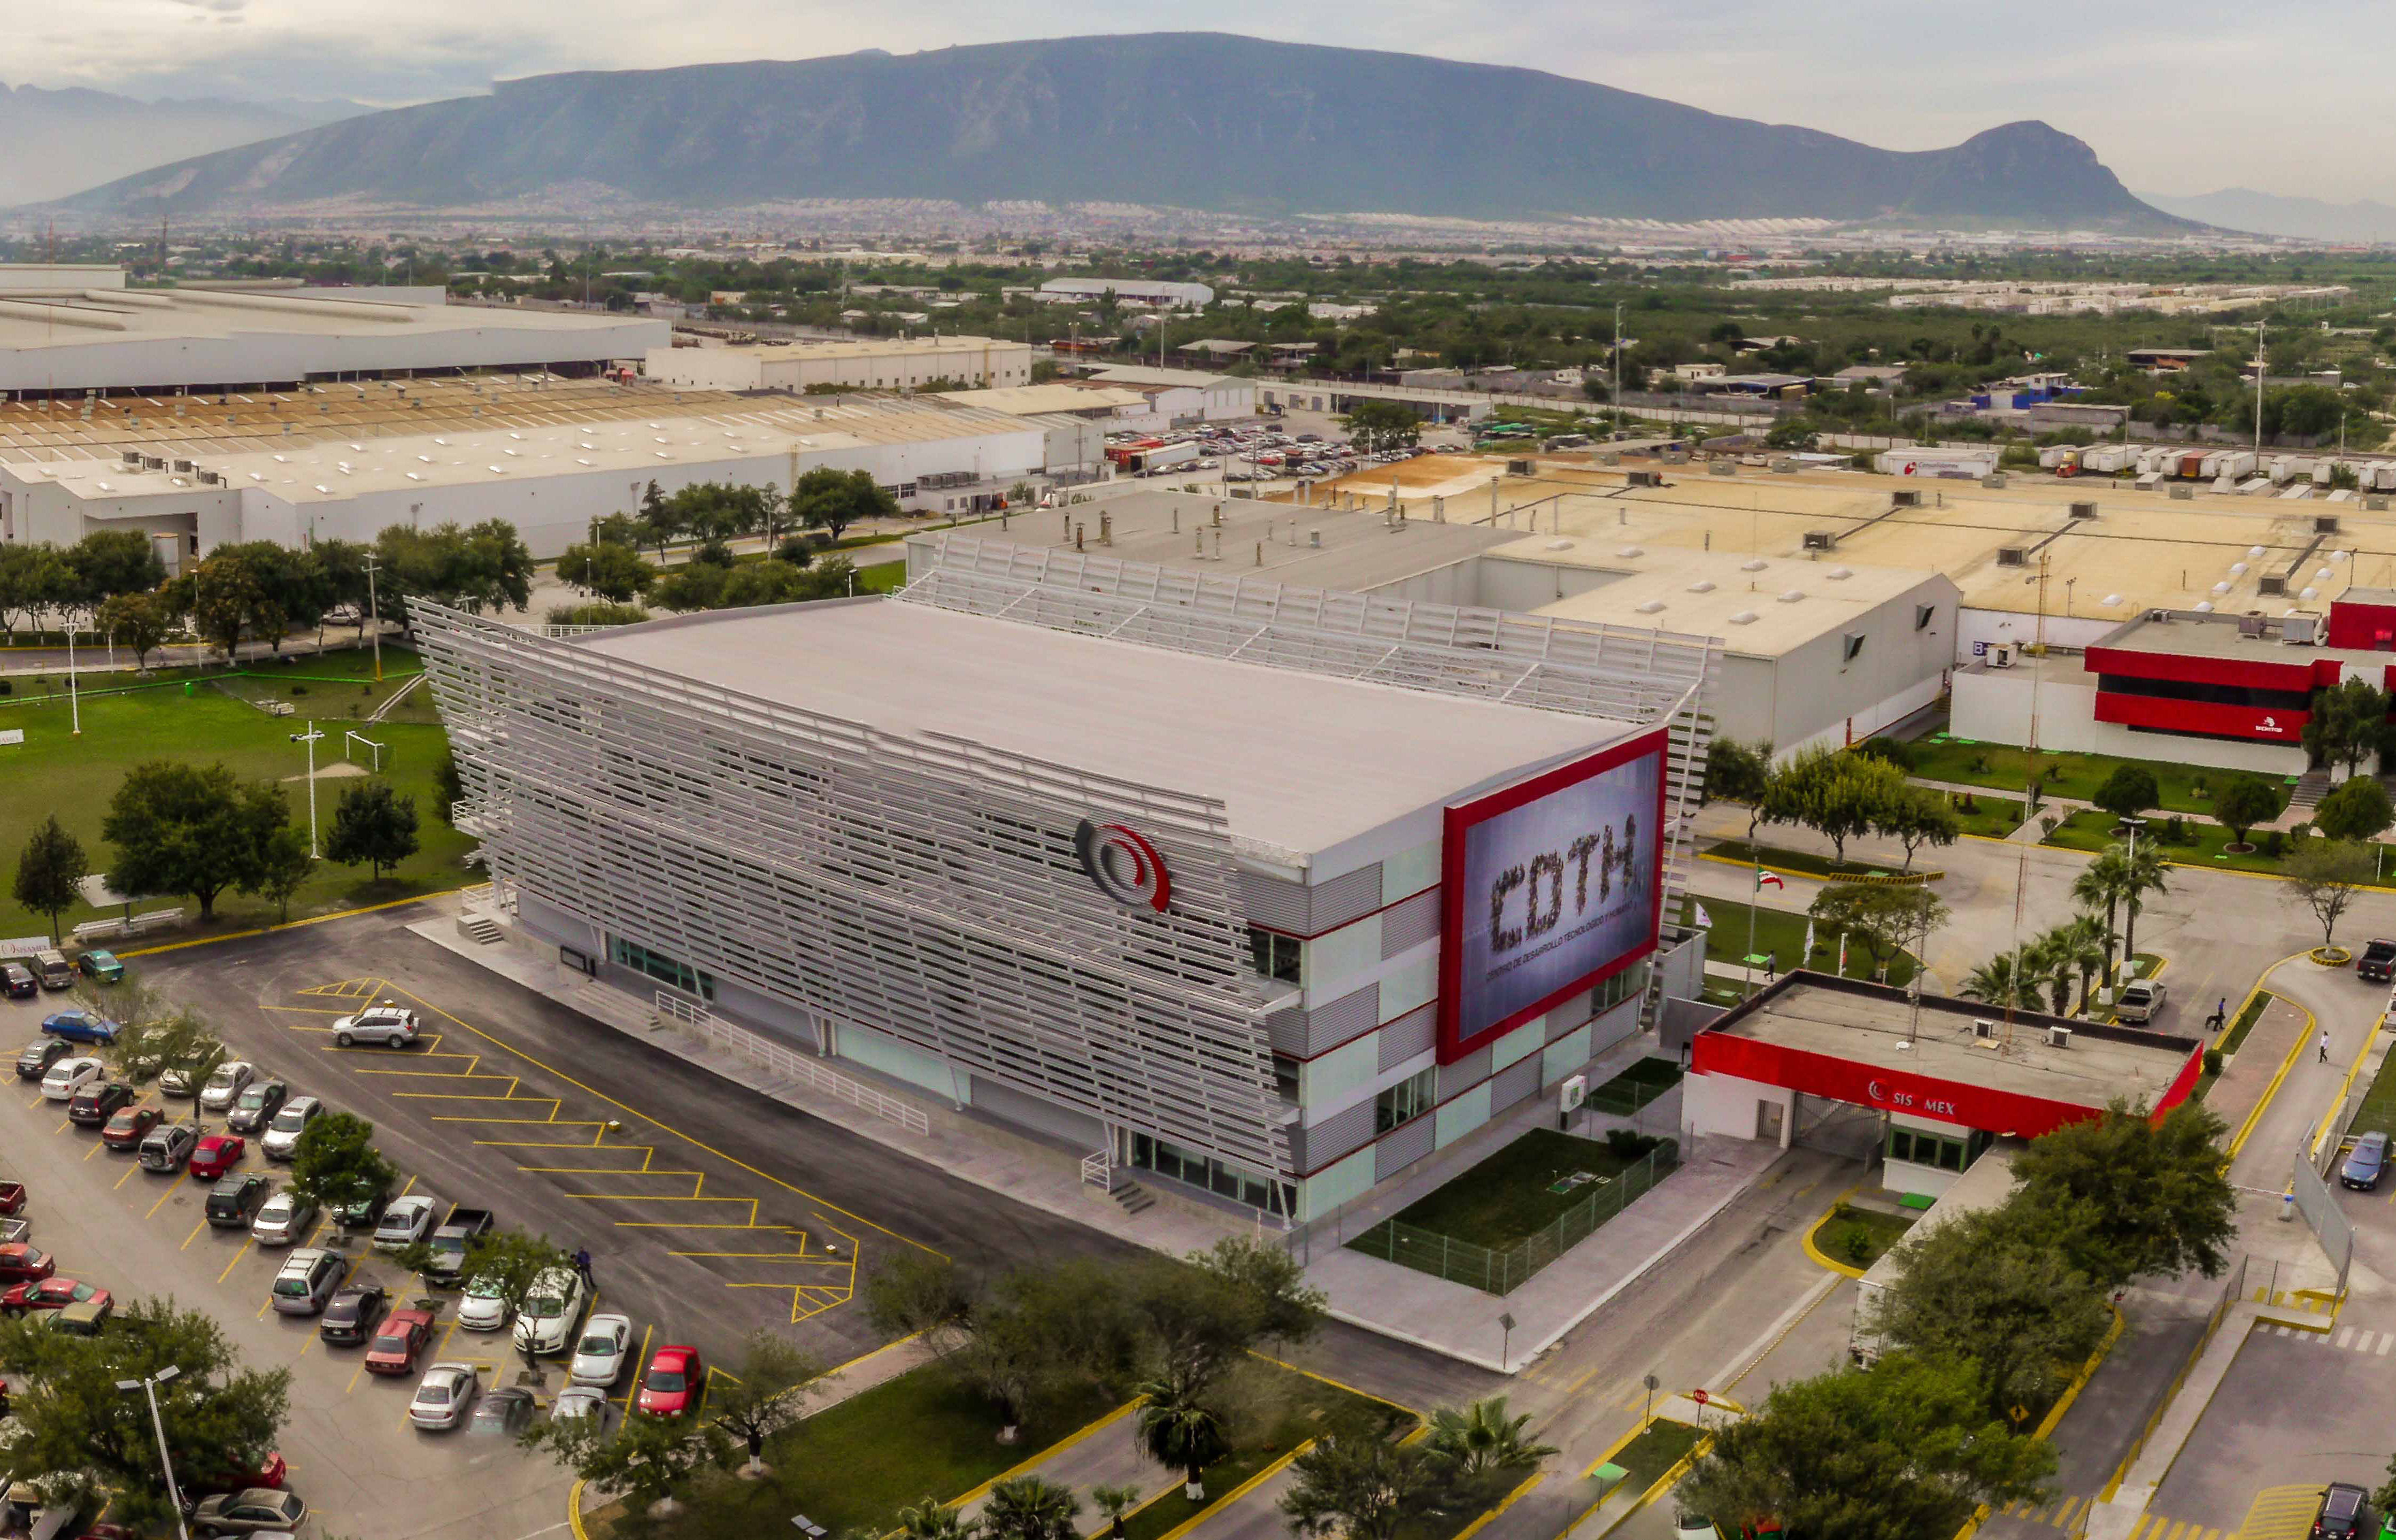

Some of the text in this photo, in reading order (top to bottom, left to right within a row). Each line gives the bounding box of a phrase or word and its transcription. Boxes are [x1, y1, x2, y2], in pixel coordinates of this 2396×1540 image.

[1491, 813, 1636, 951] CDTH
[1893, 1093, 1955, 1115] SIS MEX
[1695, 1392, 1707, 1400] ALTO
